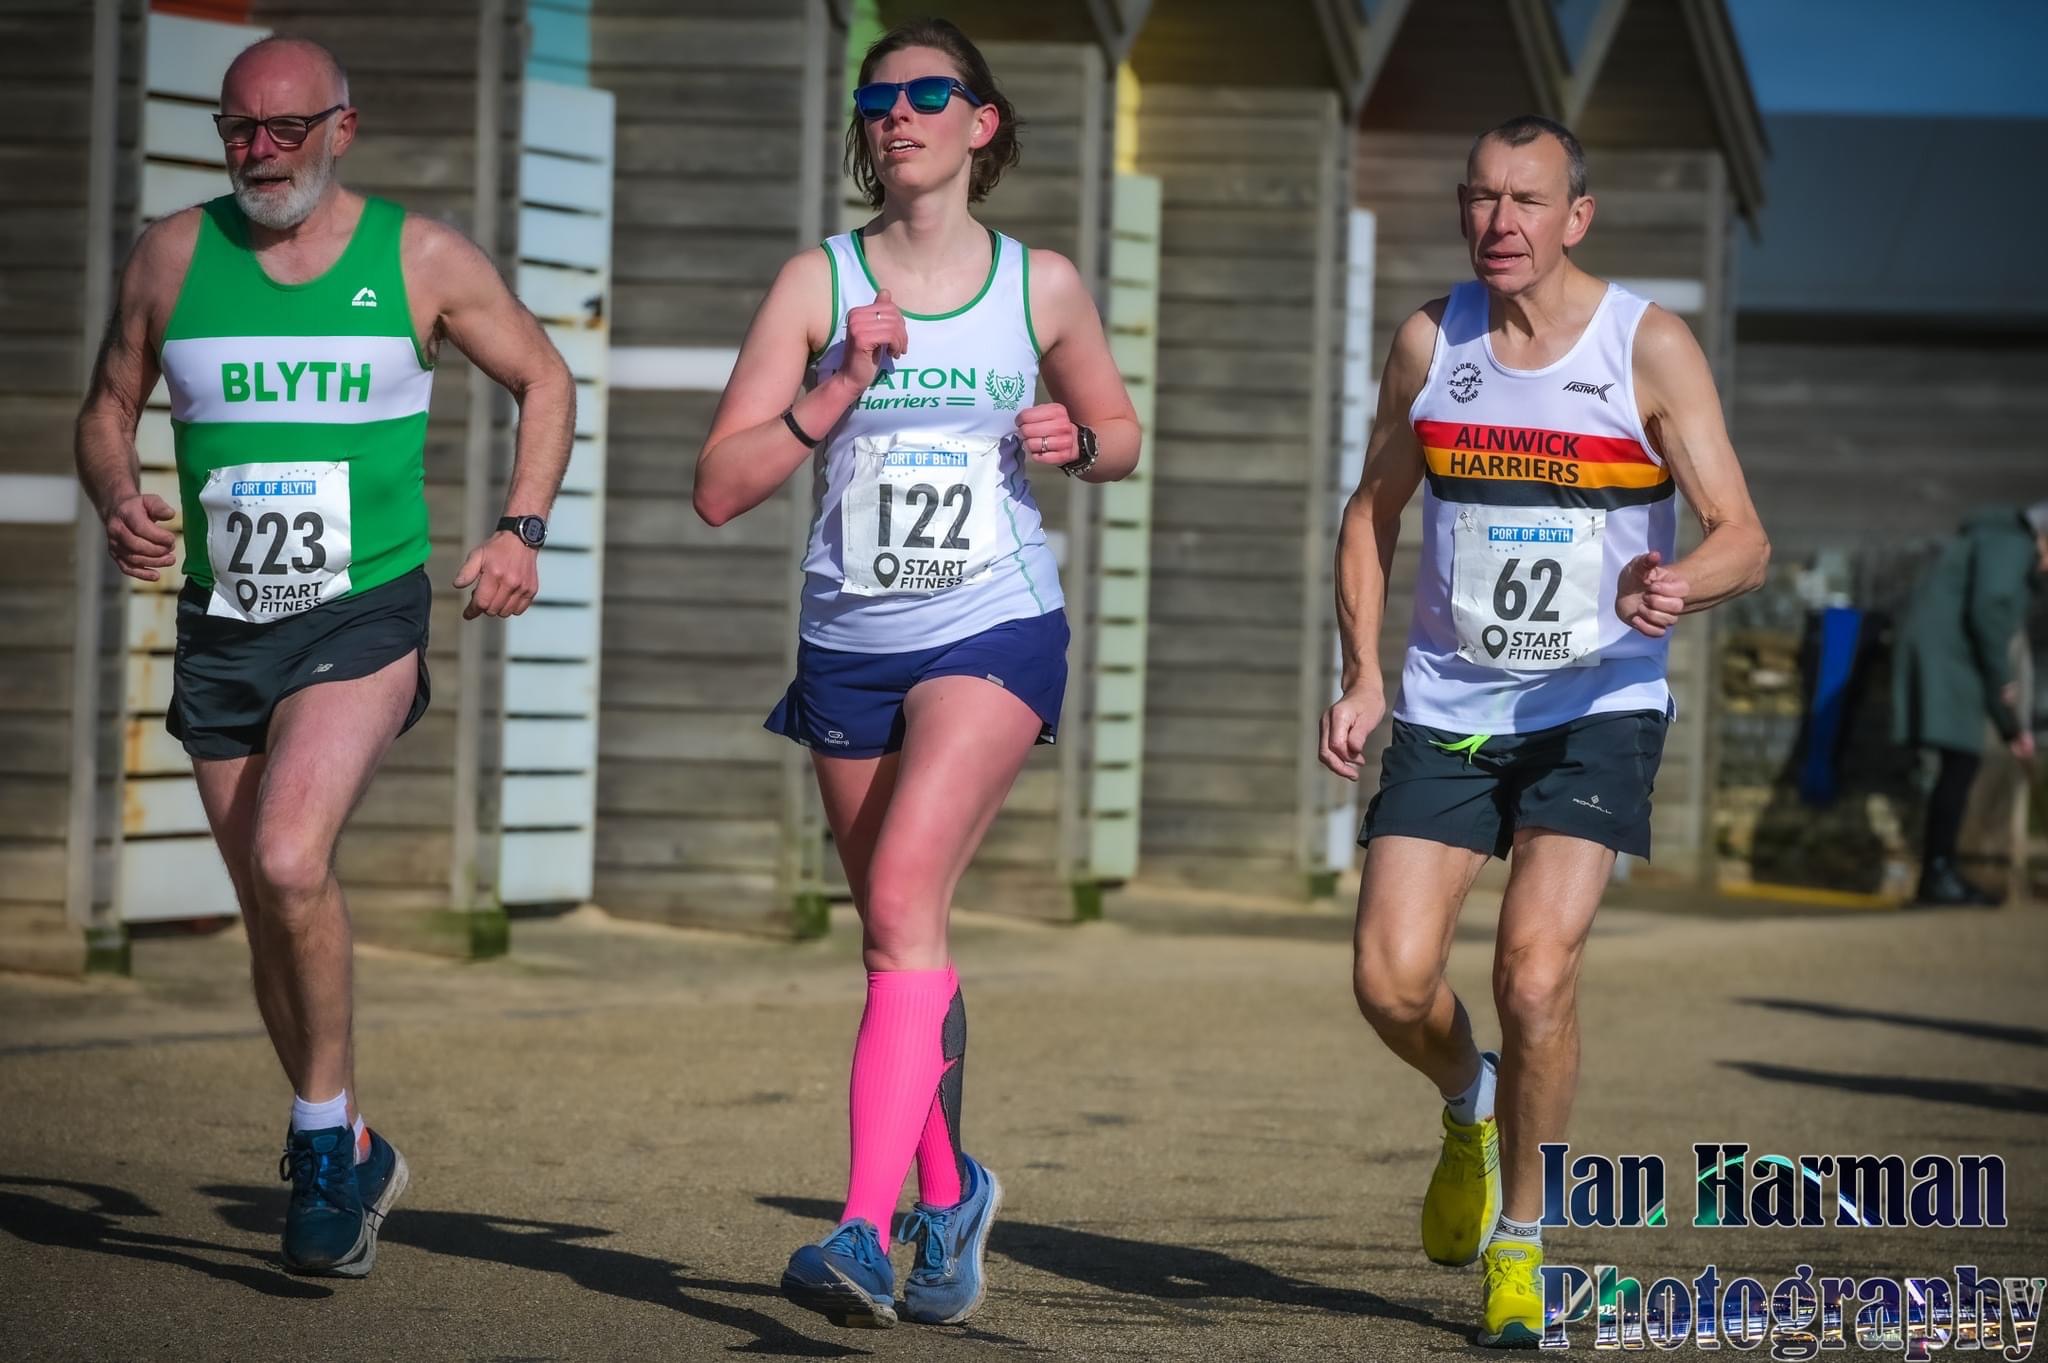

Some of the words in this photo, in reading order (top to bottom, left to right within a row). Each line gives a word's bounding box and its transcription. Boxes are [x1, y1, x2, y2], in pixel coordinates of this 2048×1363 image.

[221, 361, 372, 403] BLYTH
[868, 367, 976, 390] ATON
[856, 393, 941, 410] Harriers
[1454, 426, 1581, 459] ALNWICK
[886, 452, 911, 465] PORT
[915, 453, 928, 465] OF
[933, 453, 965, 466] BLYTH
[1450, 452, 1580, 485] HARRIERS
[234, 482, 261, 495] PORT
[264, 482, 278, 494] OF
[281, 481, 313, 494] BLYTH
[878, 483, 973, 550] 122
[1491, 527, 1518, 540] PORT
[1522, 528, 1536, 541] OF
[1539, 529, 1570, 541] BLYTH
[226, 511, 327, 575] 223
[903, 559, 967, 576] START
[261, 581, 323, 600] START
[900, 576, 964, 589] FITNESS
[1493, 558, 1562, 622] 62
[260, 597, 322, 613] FITNESS
[1511, 631, 1573, 648] START
[1508, 649, 1570, 660] FITNESS
